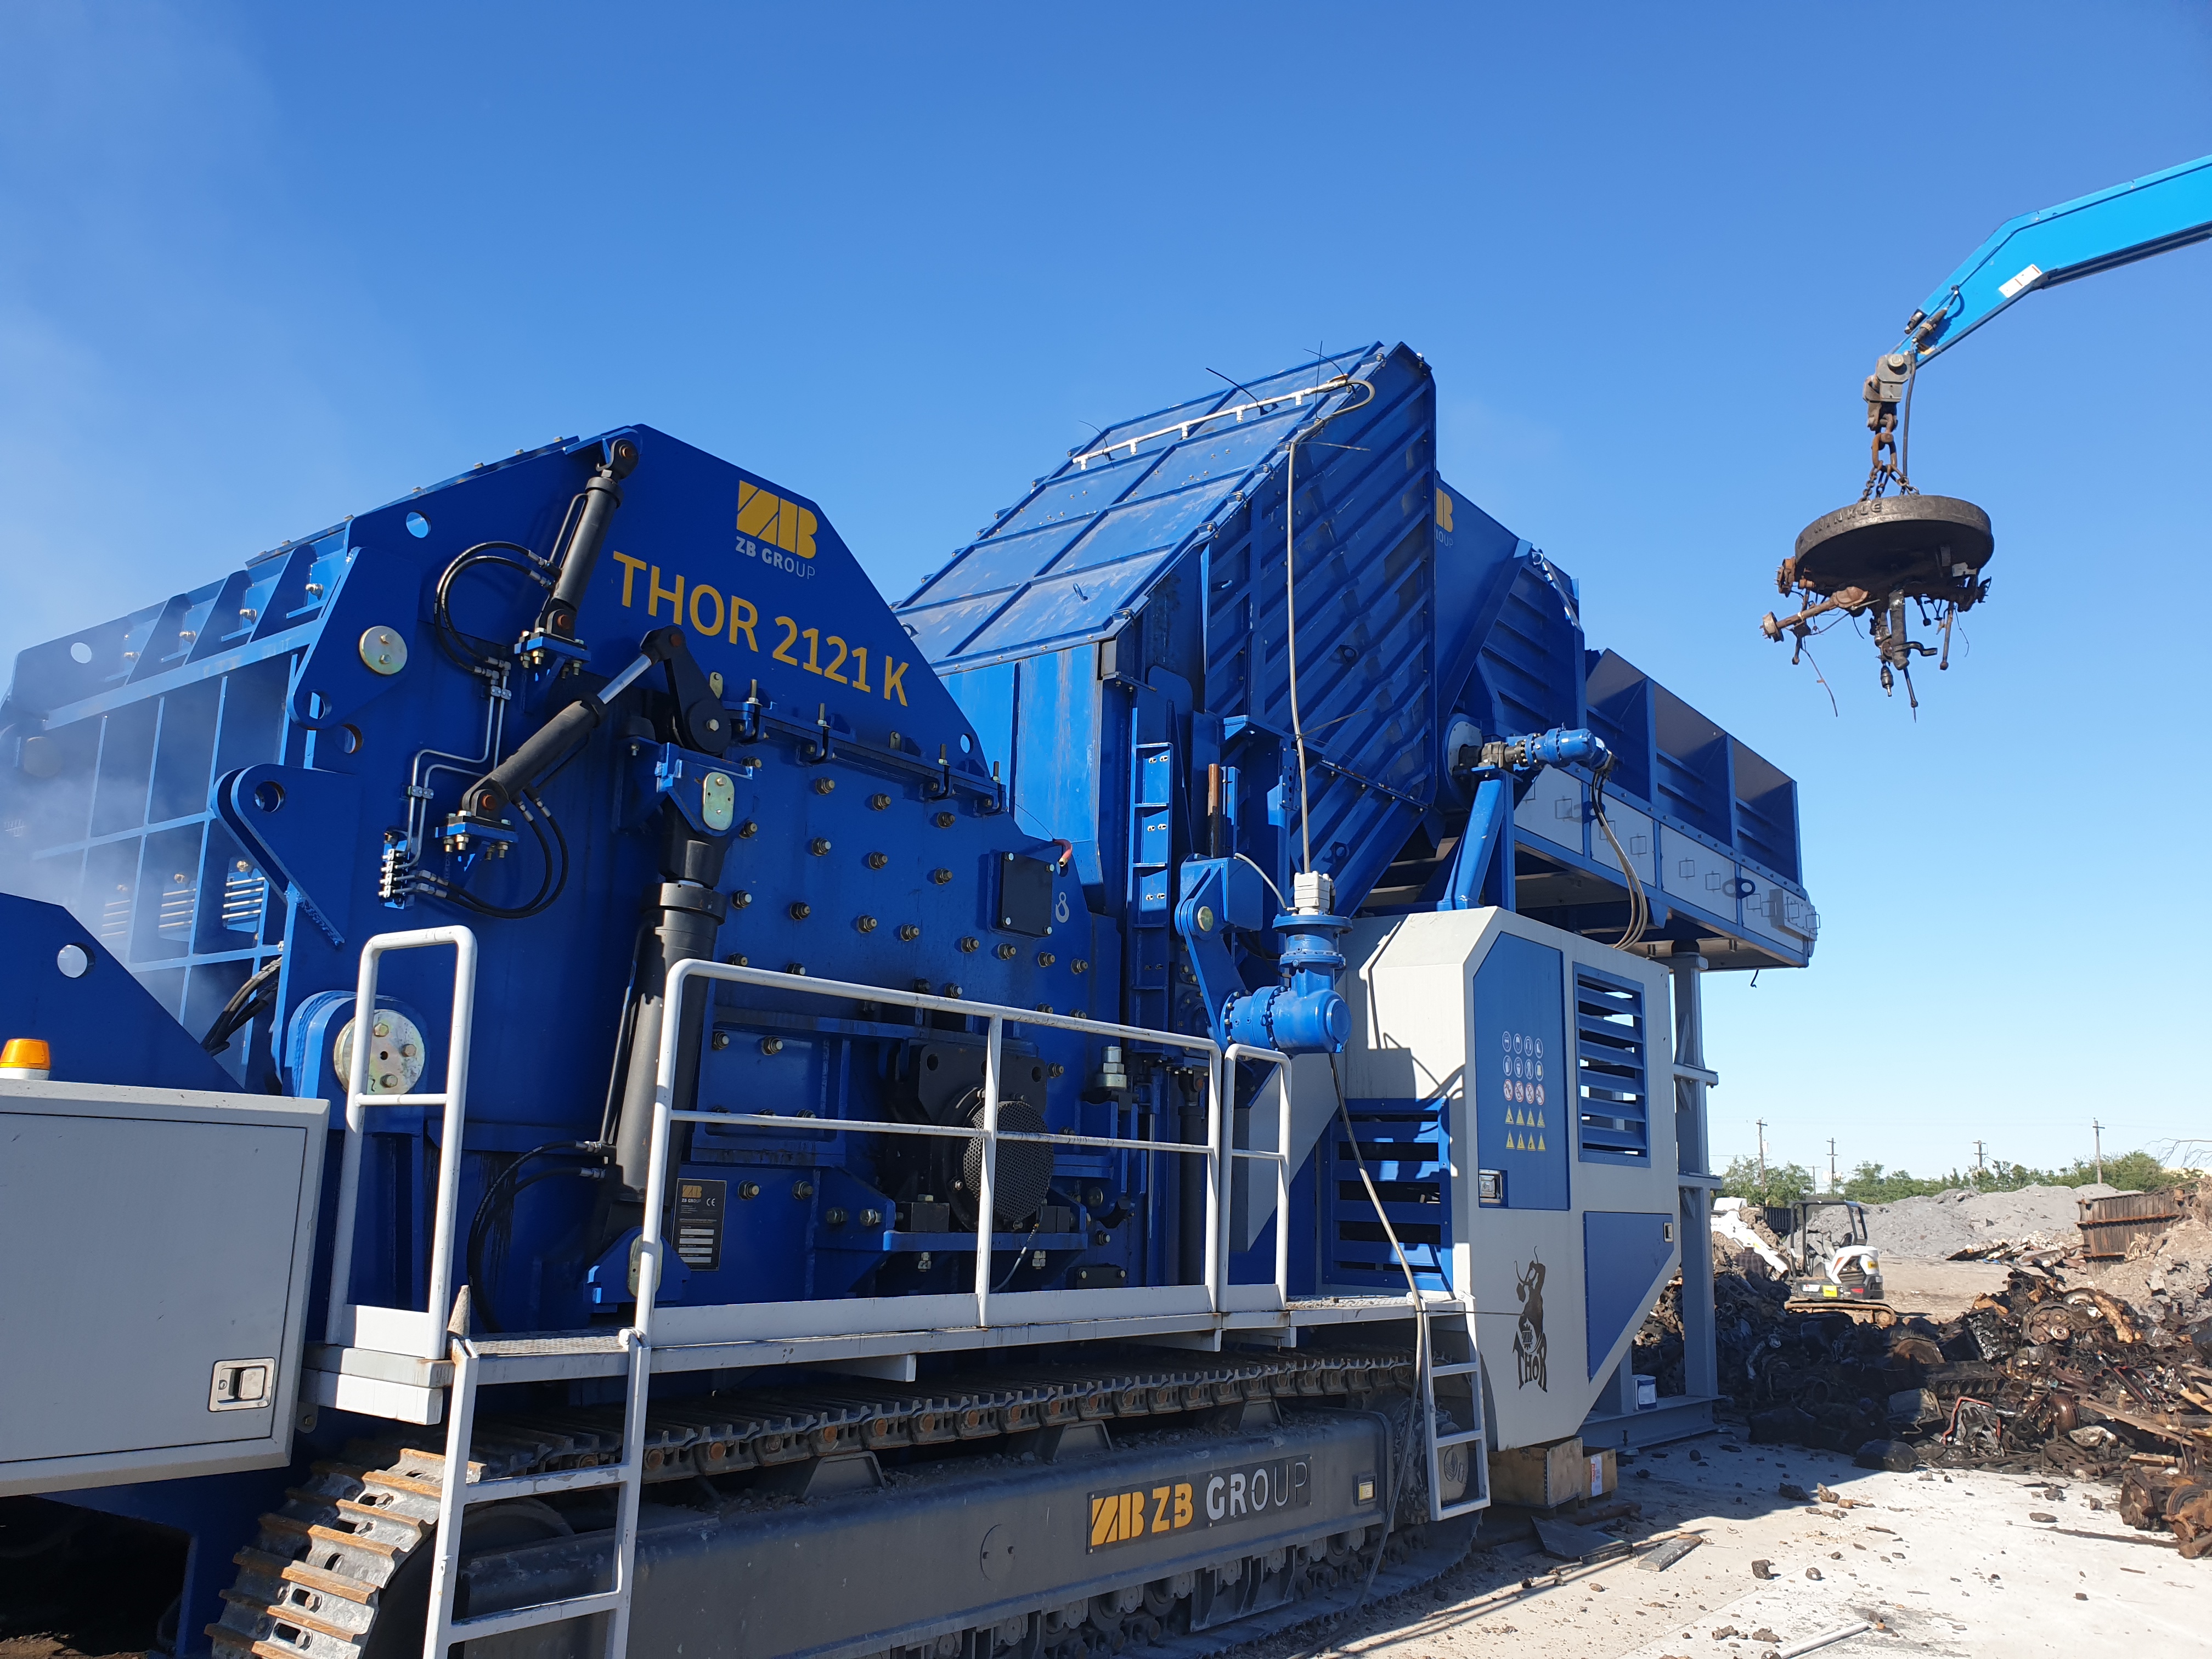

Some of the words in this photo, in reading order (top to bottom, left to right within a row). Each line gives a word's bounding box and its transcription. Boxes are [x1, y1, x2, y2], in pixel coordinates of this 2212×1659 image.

[735, 535, 757, 557] ZB
[761, 548, 815, 580] GROUP
[1436, 529, 1453, 548] OUP
[613, 550, 759, 653] THOR
[772, 616, 871, 693] 2121
[884, 655, 909, 708] K
[706, 1198, 716, 1206] CE
[1512, 1330, 1548, 1393] THOR
[1152, 1482, 1193, 1533] ZB
[1206, 1462, 1308, 1521] GROUP
